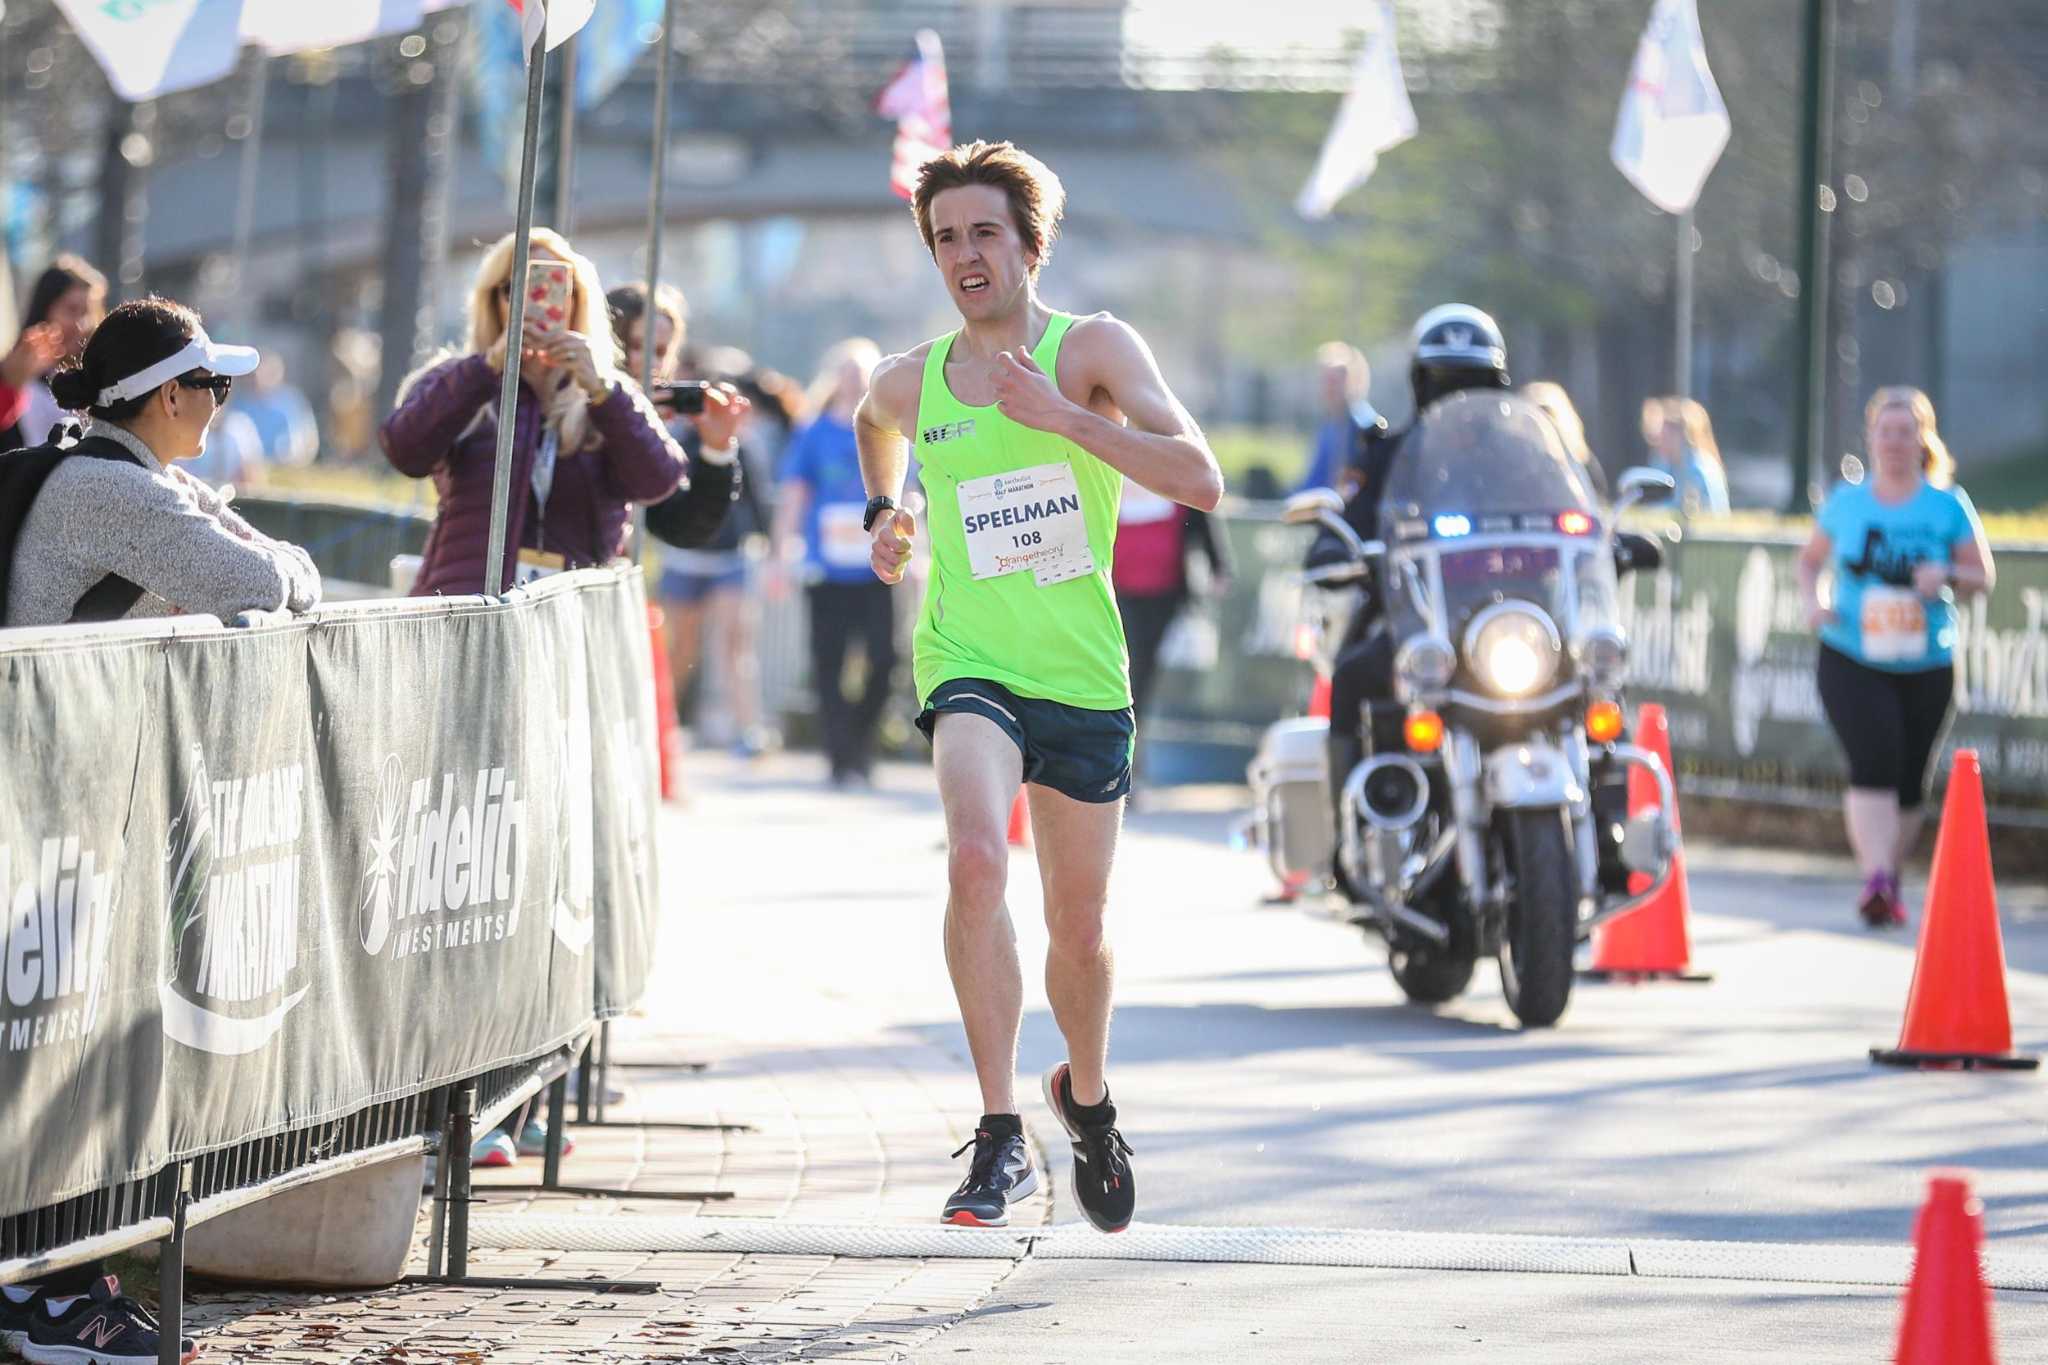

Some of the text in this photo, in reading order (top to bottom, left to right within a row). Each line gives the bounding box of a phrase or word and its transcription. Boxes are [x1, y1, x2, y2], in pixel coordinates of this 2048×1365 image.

[964, 494, 1079, 534] SPEELMAN
[1012, 531, 1042, 548] 108
[397, 767, 527, 937] Fidelity
